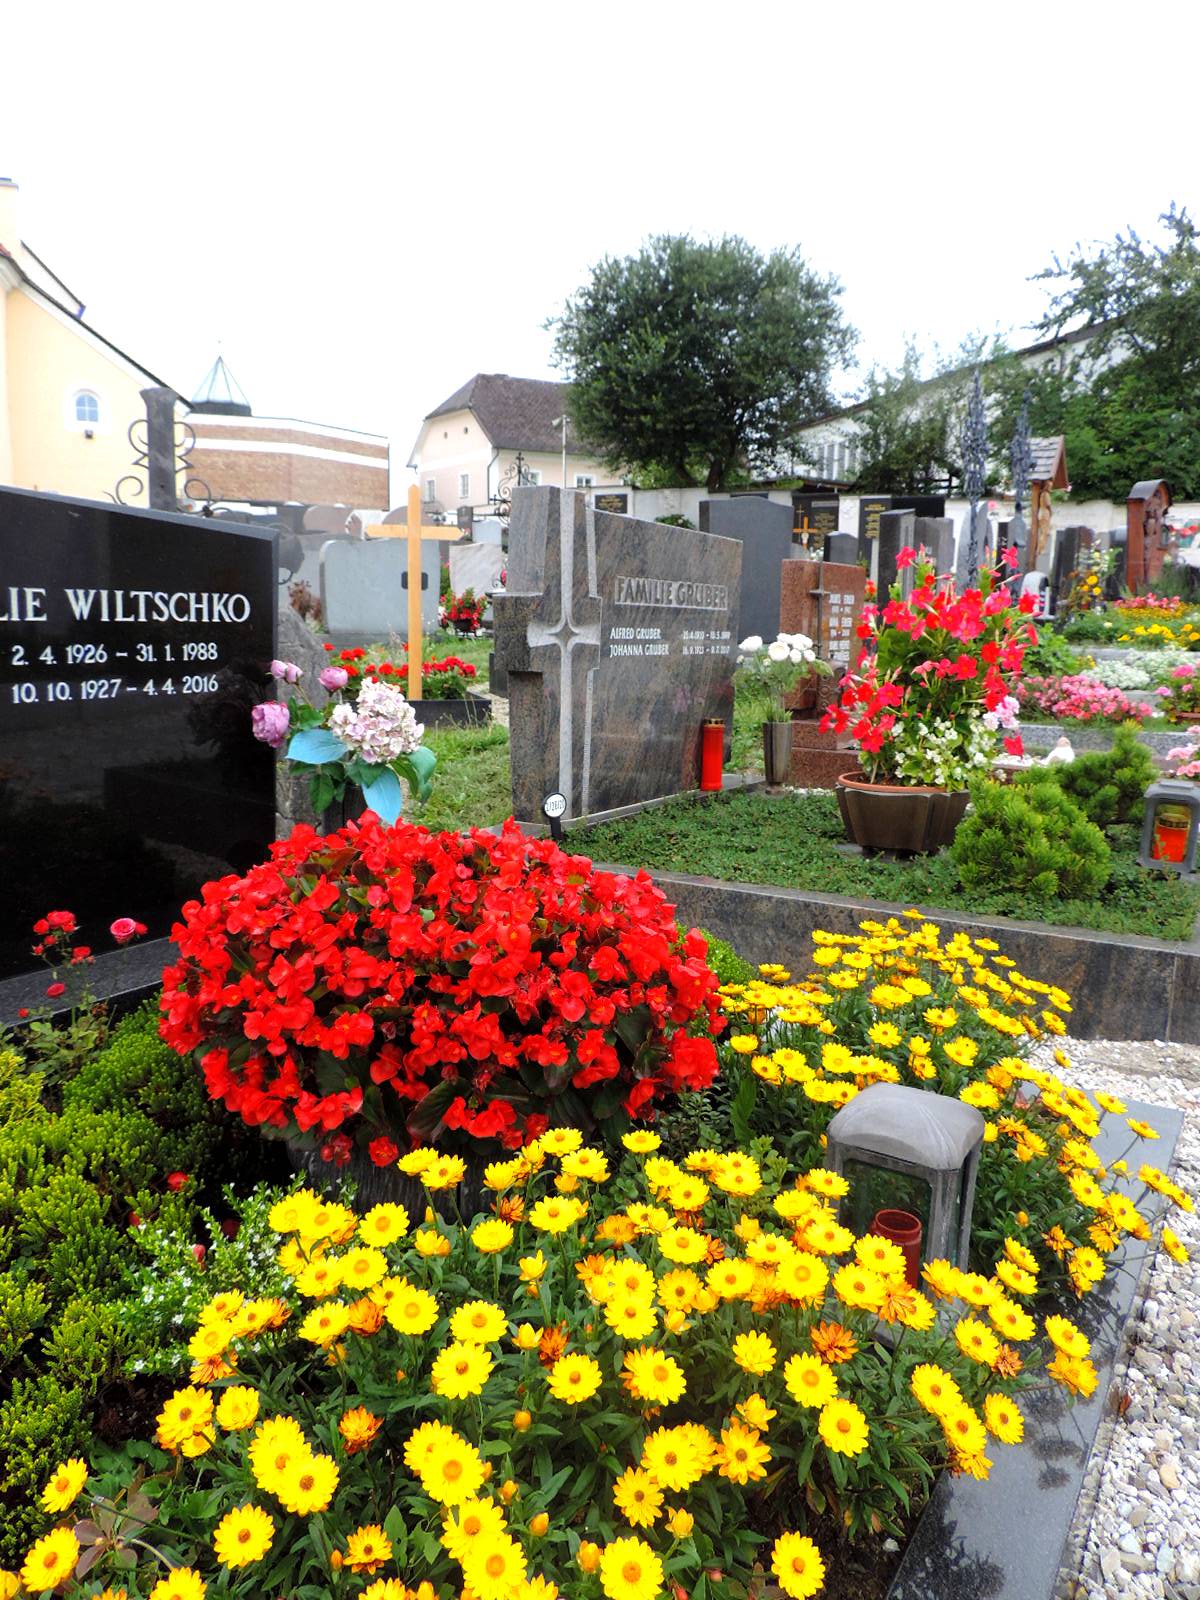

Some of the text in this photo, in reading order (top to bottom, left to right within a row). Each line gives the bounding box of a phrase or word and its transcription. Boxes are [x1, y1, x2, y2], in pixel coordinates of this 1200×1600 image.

[616, 577, 727, 608] FAMILIE GRUBER
[64, 588, 251, 623] WILTSCHKO
[610, 627, 662, 640] ALFRED GRUBER
[66, 644, 108, 663] 1926
[182, 643, 218, 660] 1988
[610, 644, 669, 658] JOHANNA GRUBER
[80, 678, 122, 700] 1927
[182, 674, 219, 694] 2016
